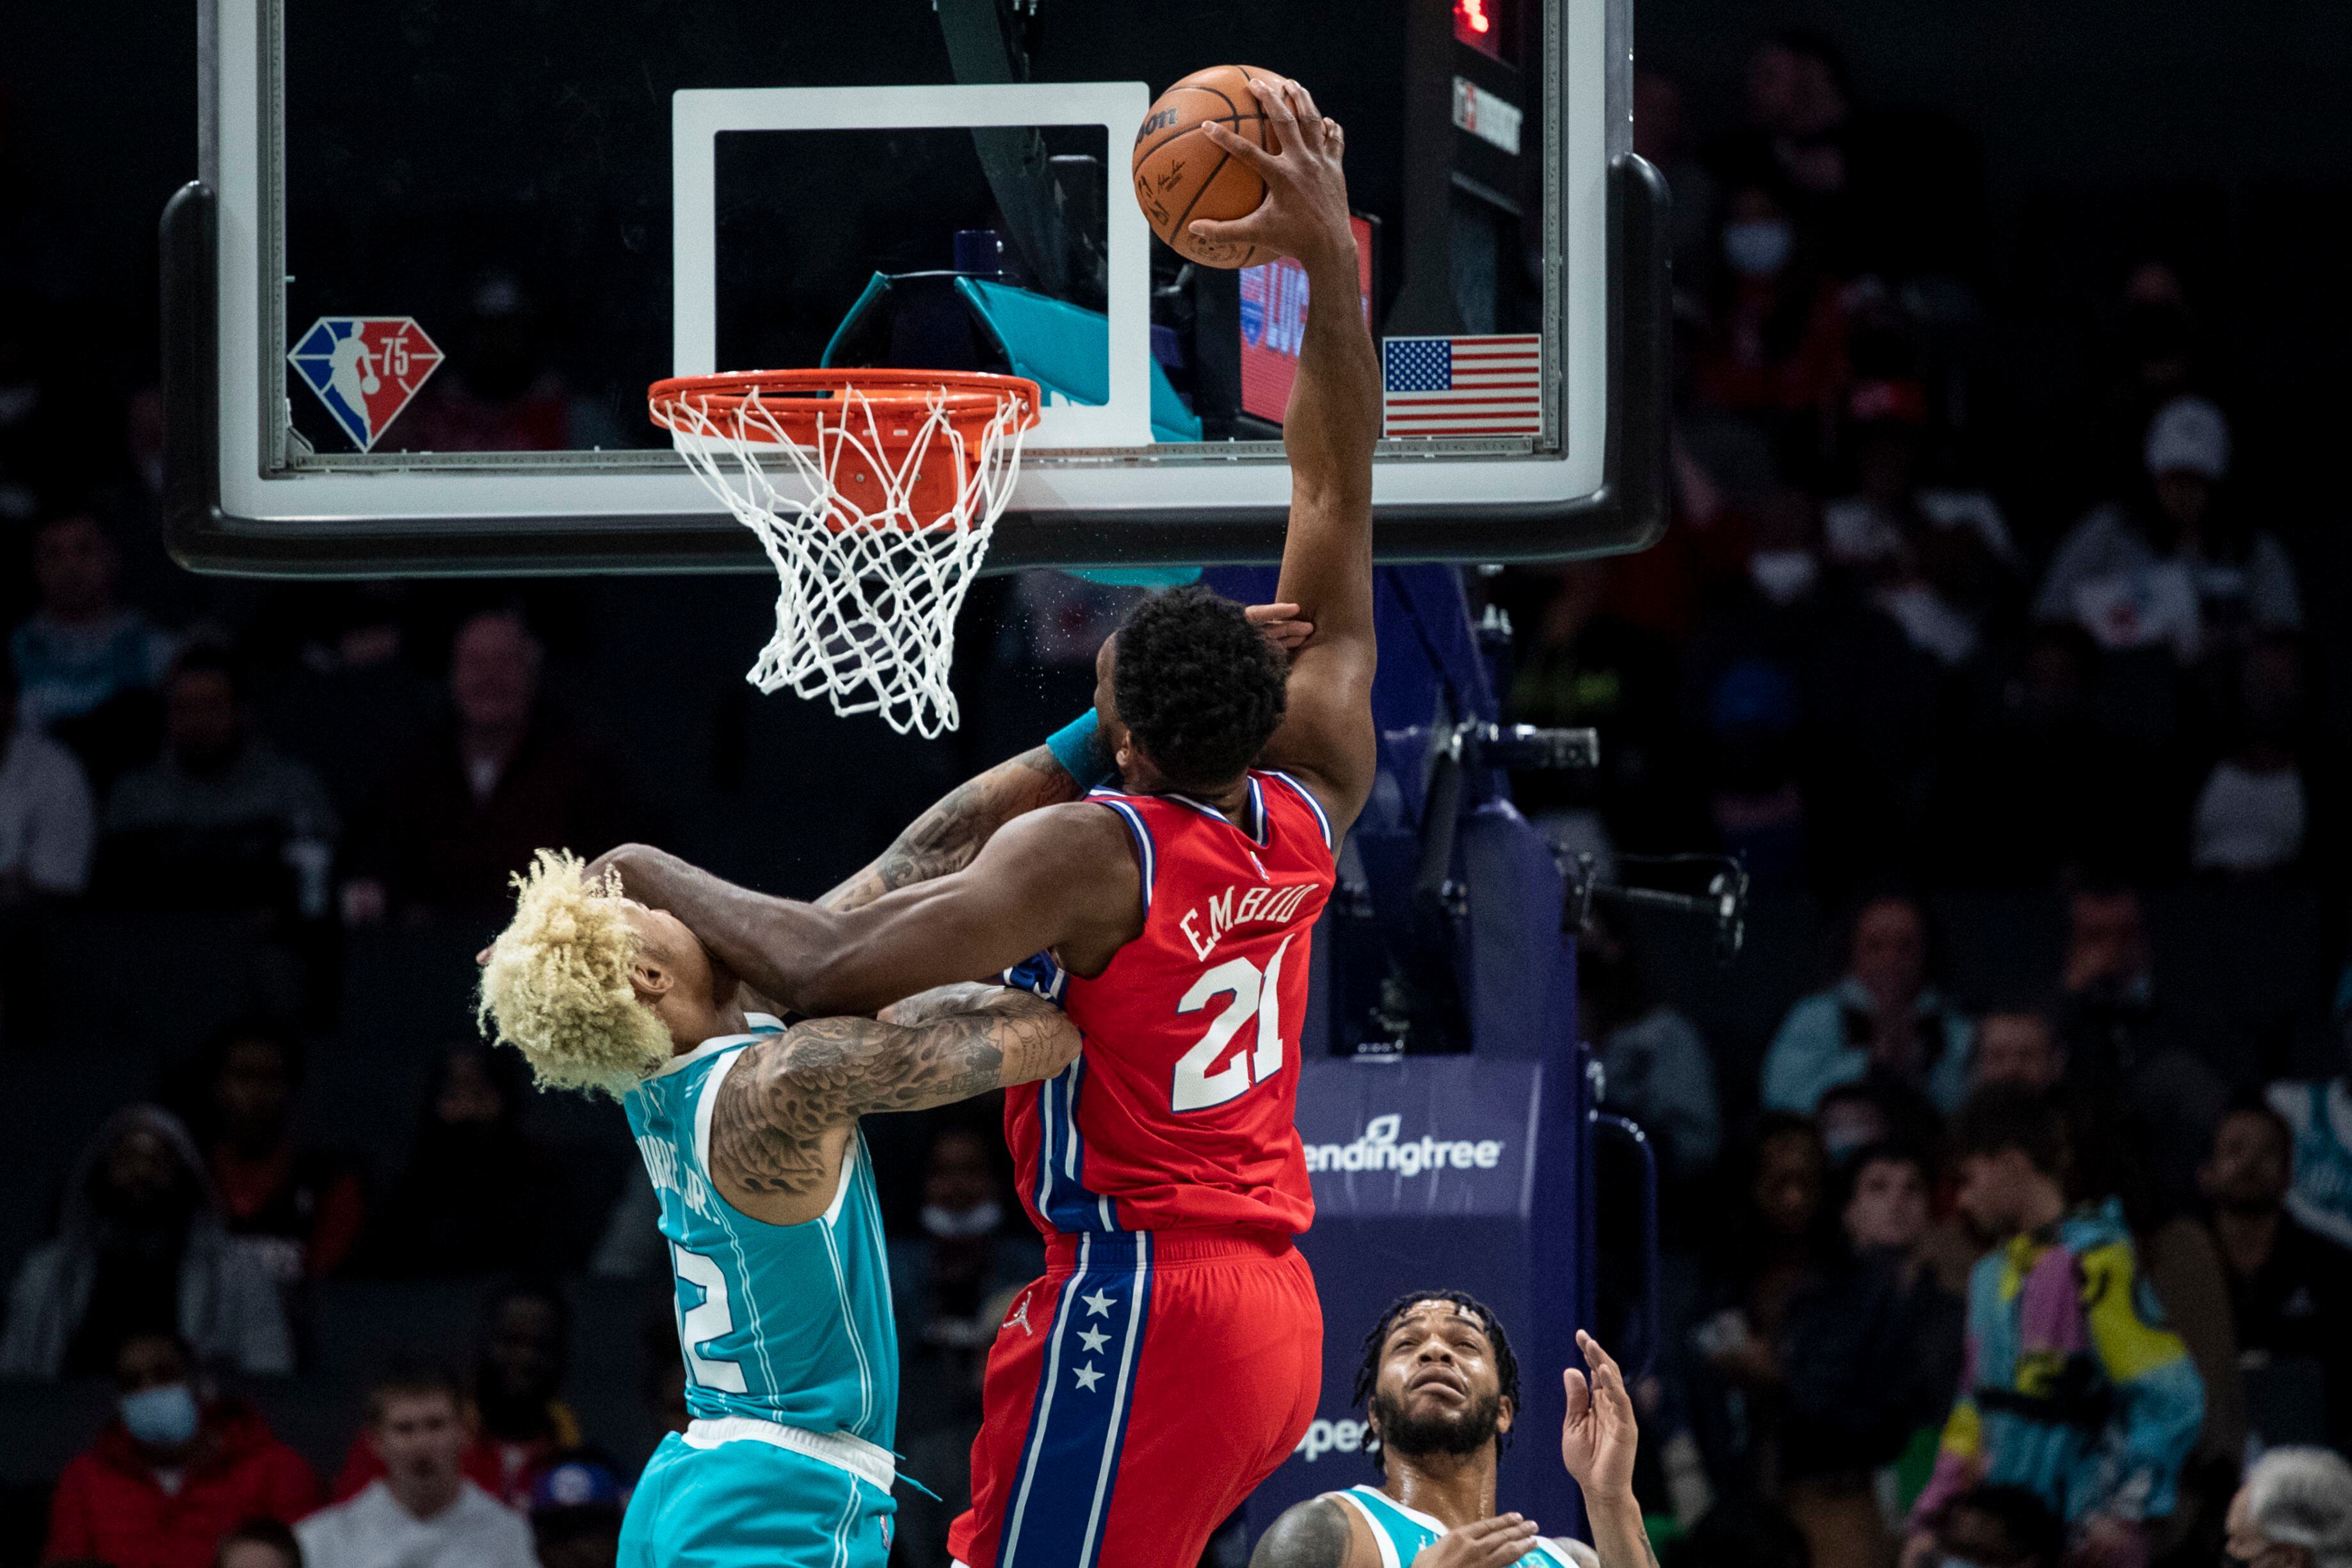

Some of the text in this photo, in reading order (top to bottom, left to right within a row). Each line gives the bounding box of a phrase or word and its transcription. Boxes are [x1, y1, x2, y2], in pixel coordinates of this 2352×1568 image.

[380, 337, 409, 376] 75
[1179, 883, 1319, 962] EMBIID
[1170, 932, 1295, 1114] 21
[1303, 1135, 1502, 1177] endingtree
